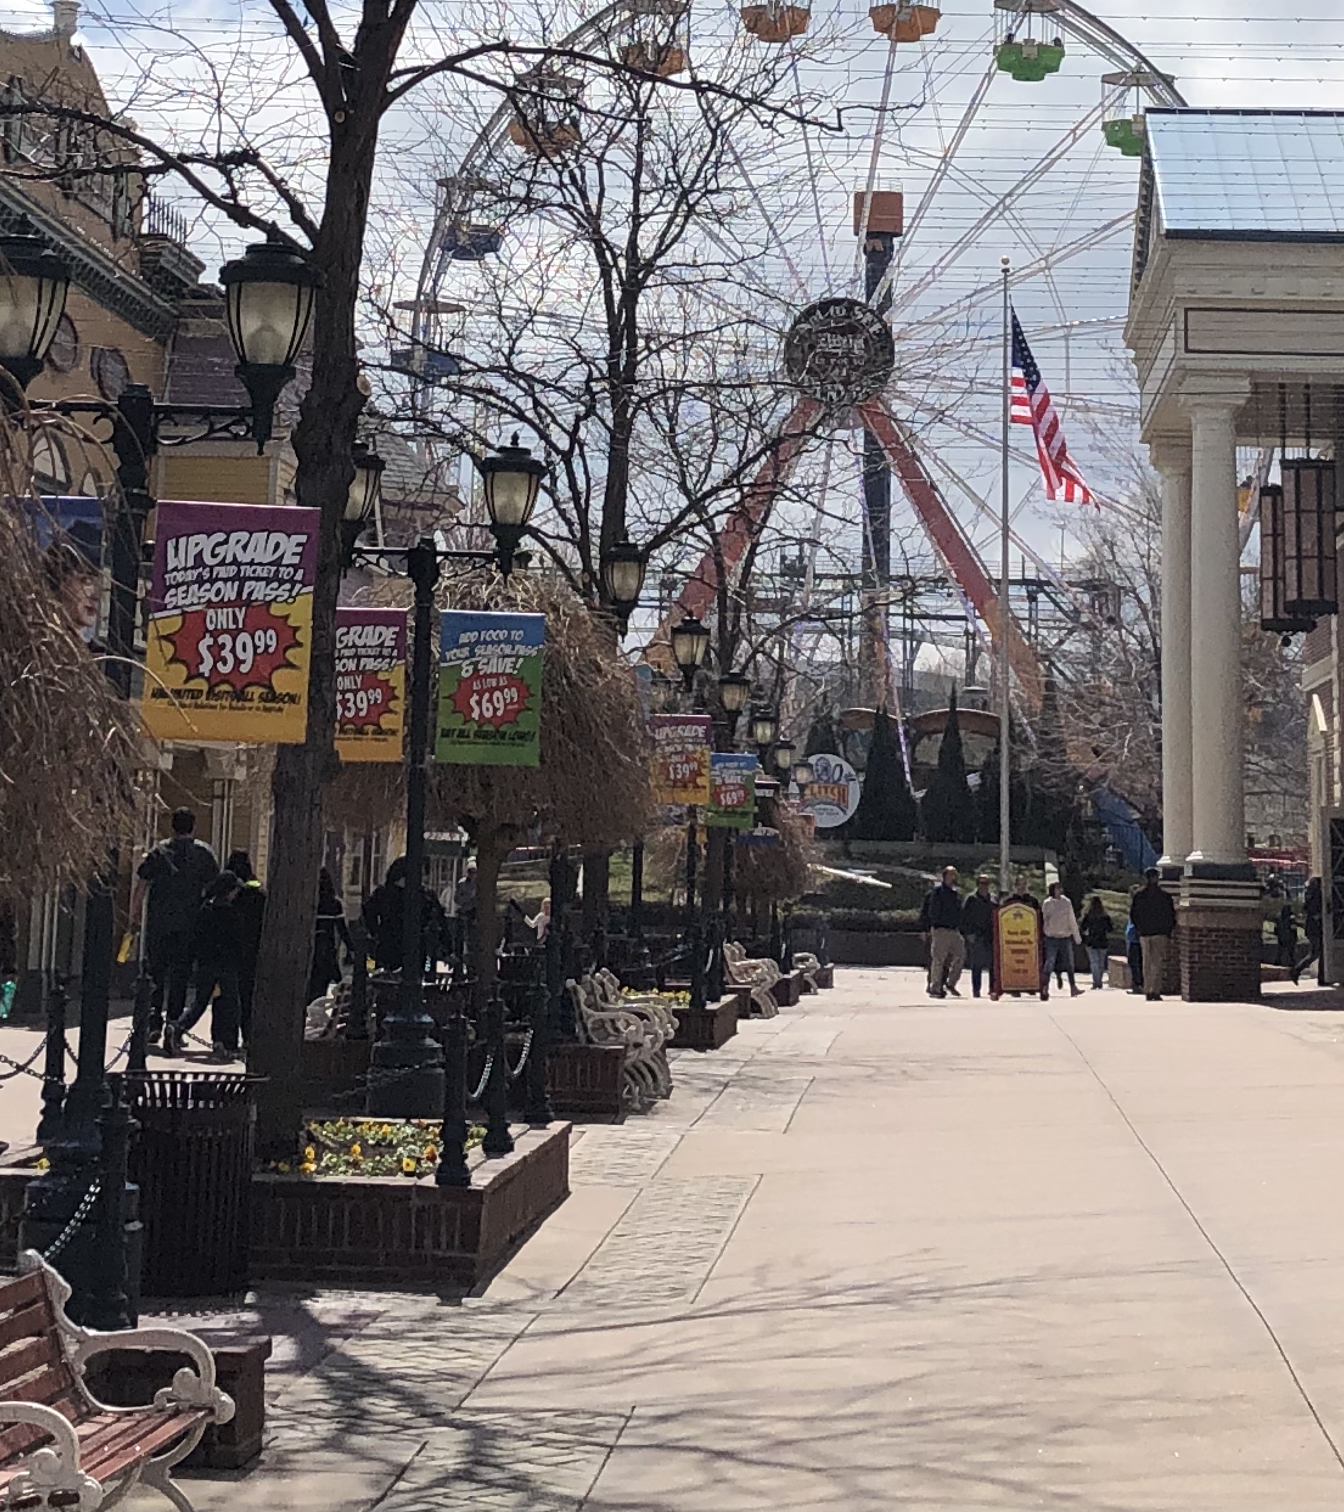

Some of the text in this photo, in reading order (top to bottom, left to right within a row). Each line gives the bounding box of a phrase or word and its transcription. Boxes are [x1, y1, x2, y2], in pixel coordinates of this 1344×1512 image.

[166, 531, 308, 571] UPGRADE
[164, 566, 304, 586] TODAY'S PAID TICKET TO A
[164, 581, 302, 609] SEASON PASS!
[207, 607, 247, 630] ONLY
[336, 625, 400, 649] GRADE
[459, 630, 524, 644] ADD FOOD TO
[478, 657, 524, 675] SAVE!
[337, 674, 362, 690] ONLY
[808, 784, 847, 807] LITCH
